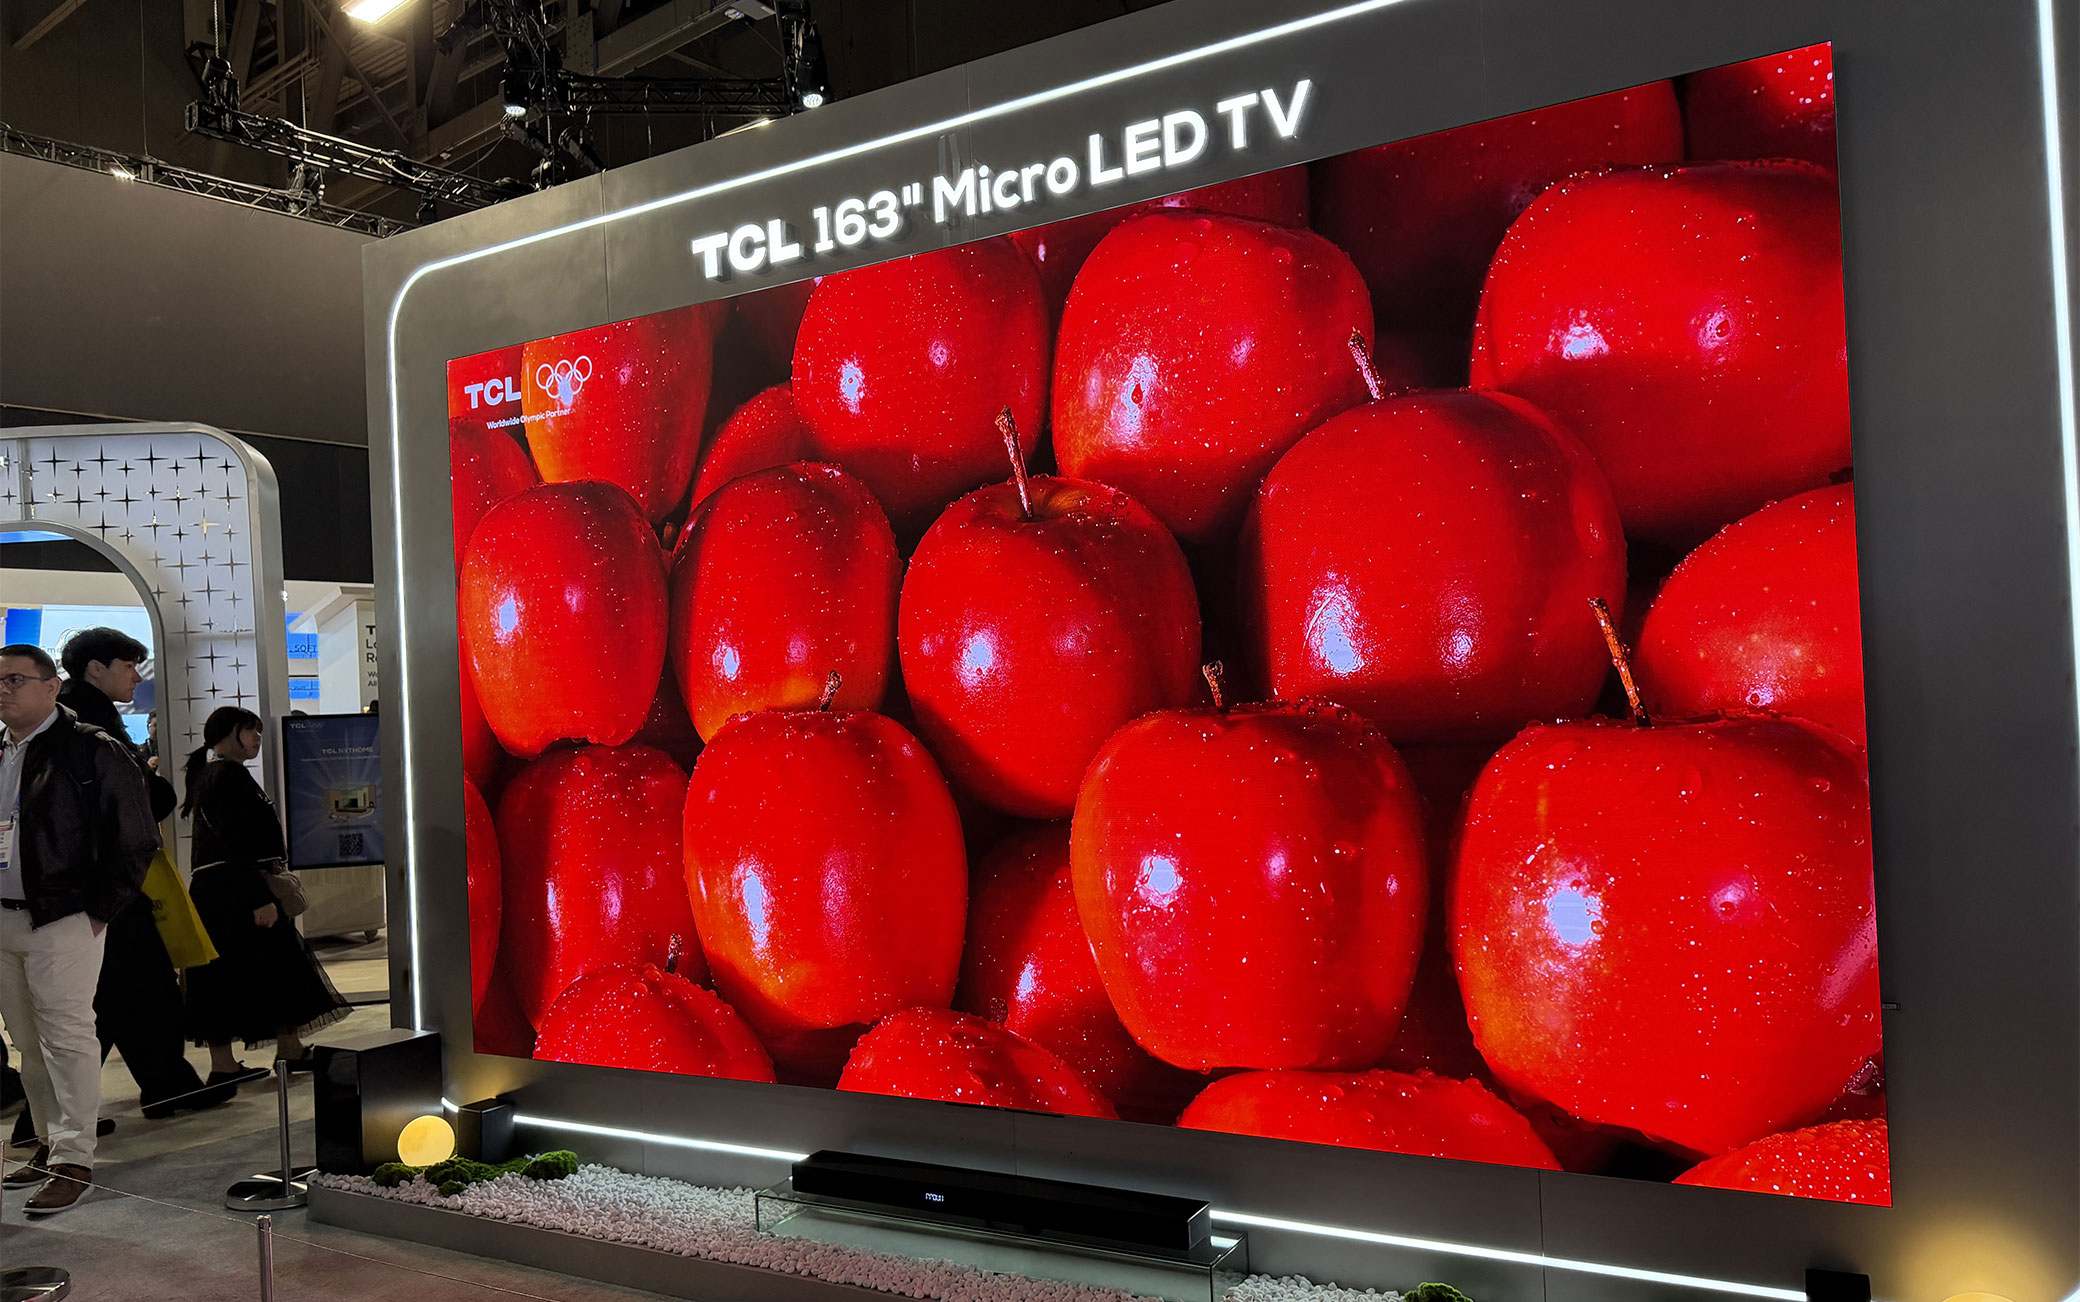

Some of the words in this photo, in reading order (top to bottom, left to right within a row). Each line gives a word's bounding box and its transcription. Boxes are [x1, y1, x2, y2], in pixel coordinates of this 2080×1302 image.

[693, 217, 803, 279] TCL
[813, 182, 920, 253] 163"
[933, 155, 1077, 224] Micro
[1088, 109, 1209, 185] LED
[1218, 79, 1313, 150] TV
[464, 377, 522, 409] TCL
[486, 417, 520, 430] Worldwide
[520, 412, 545, 425] Olympic
[545, 408, 571, 418] Partner
